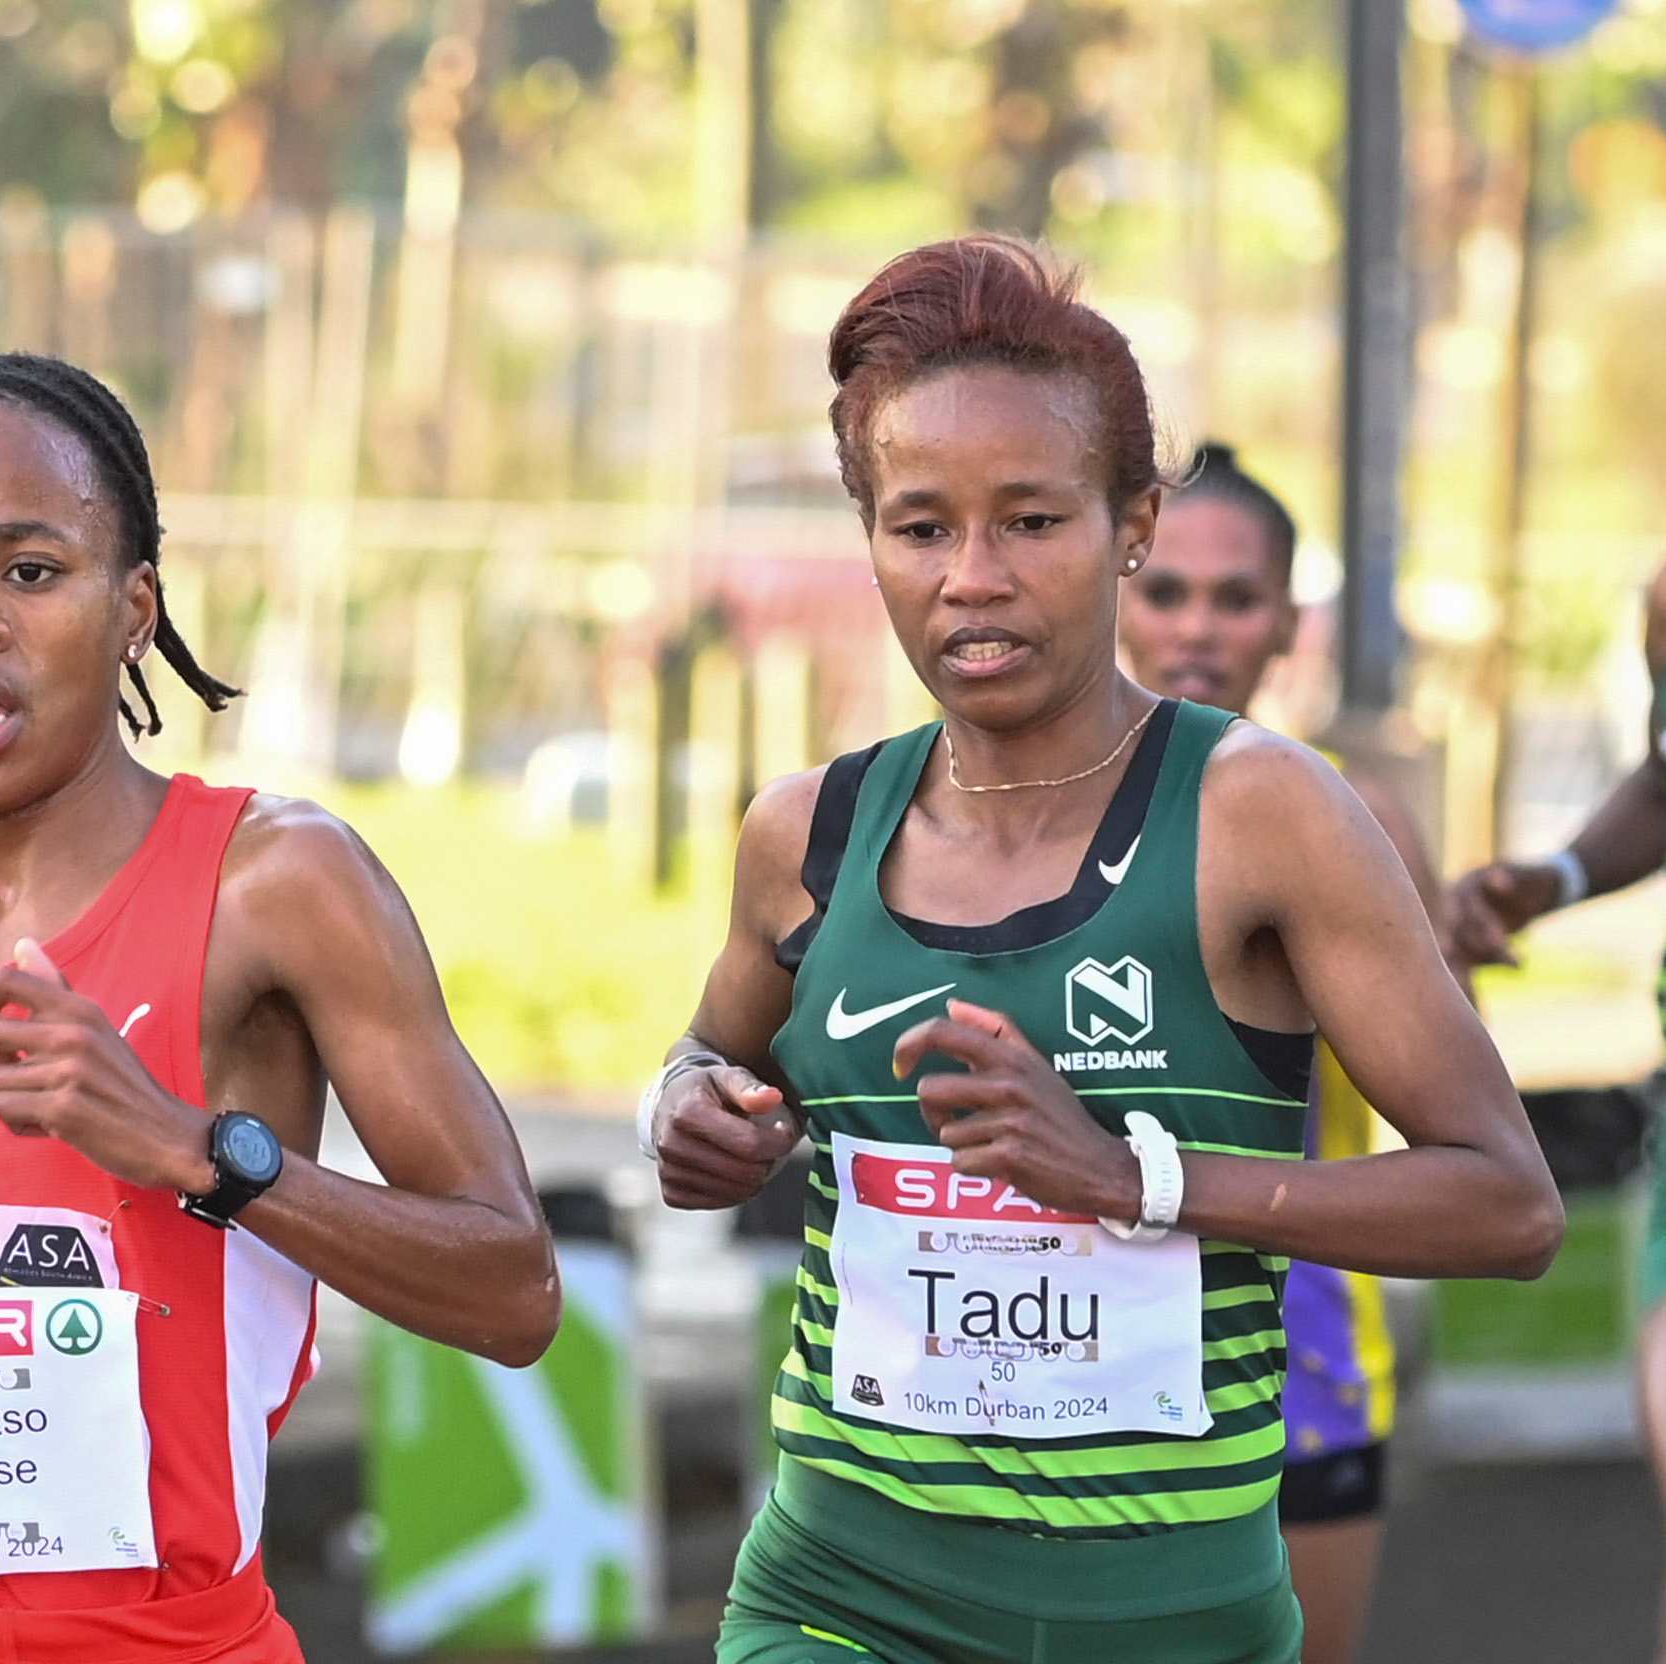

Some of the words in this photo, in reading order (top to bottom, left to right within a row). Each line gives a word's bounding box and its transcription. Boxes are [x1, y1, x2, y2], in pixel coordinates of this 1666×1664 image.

[1053, 1049, 1168, 1072] NEDBANK
[894, 1168, 1059, 1214] SPA
[7, 1233, 90, 1271] ASA
[907, 1269, 1100, 1342] Tadu
[990, 1361, 1016, 1382] 50
[855, 1377, 879, 1394] ASA
[904, 1392, 957, 1416] 10km
[966, 1397, 1045, 1420] Durban
[1053, 1396, 1109, 1420] 2024
[8, 1535, 64, 1557] 2024
